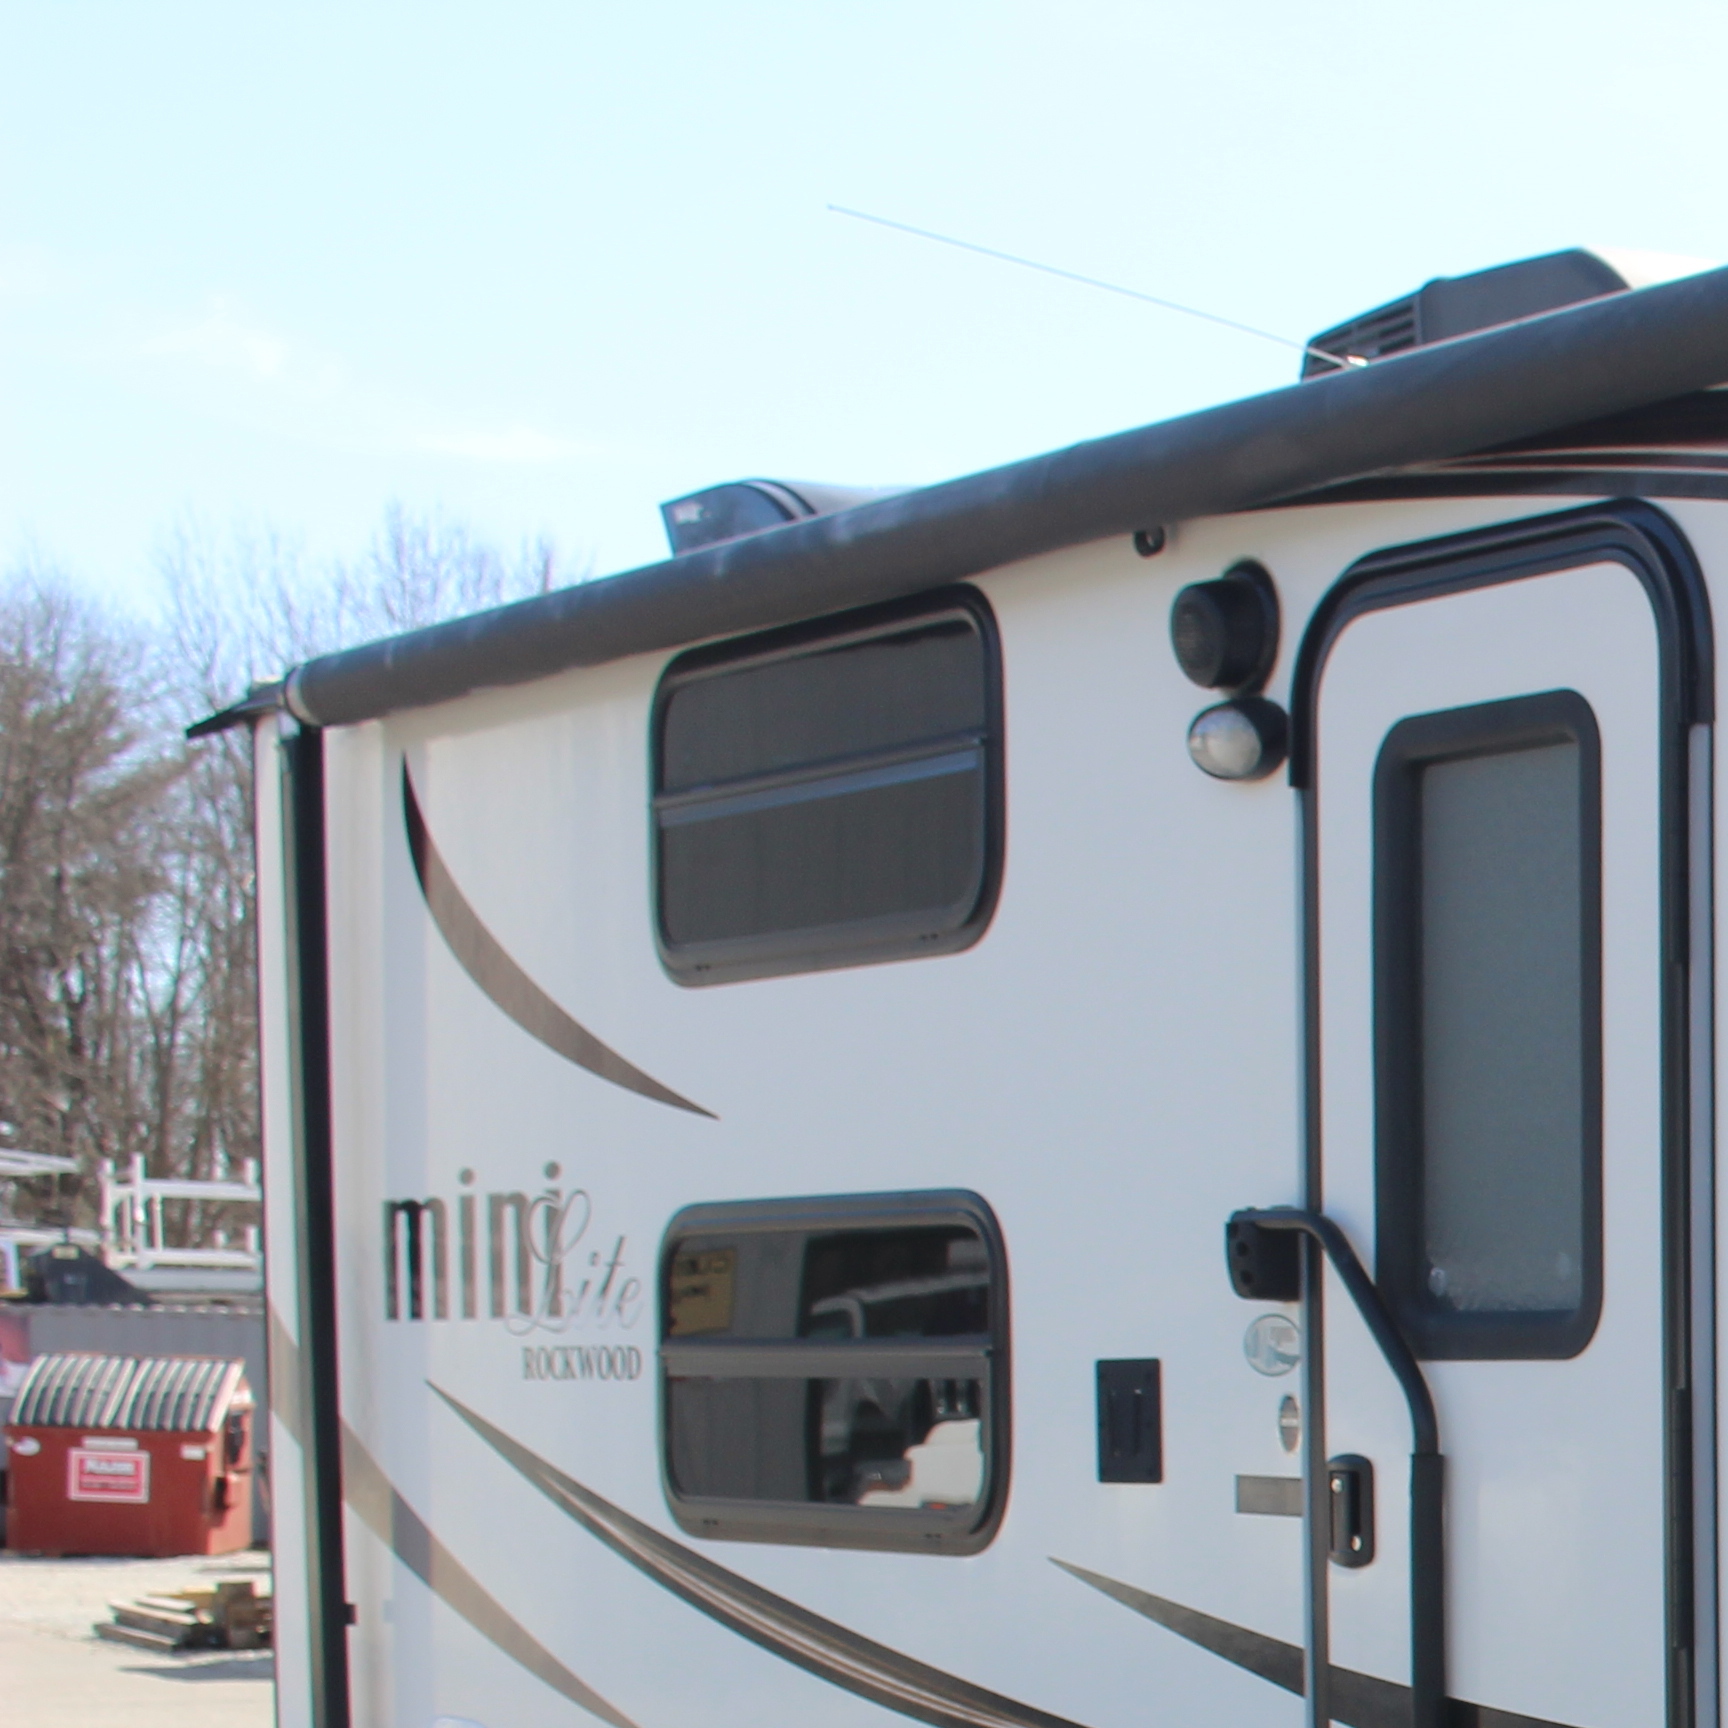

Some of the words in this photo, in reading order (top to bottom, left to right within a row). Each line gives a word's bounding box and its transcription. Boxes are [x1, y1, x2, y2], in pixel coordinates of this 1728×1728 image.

[384, 1161, 562, 1321] mini
[505, 1189, 644, 1337] Lite
[523, 1345, 642, 1381] ROCKWOOD
